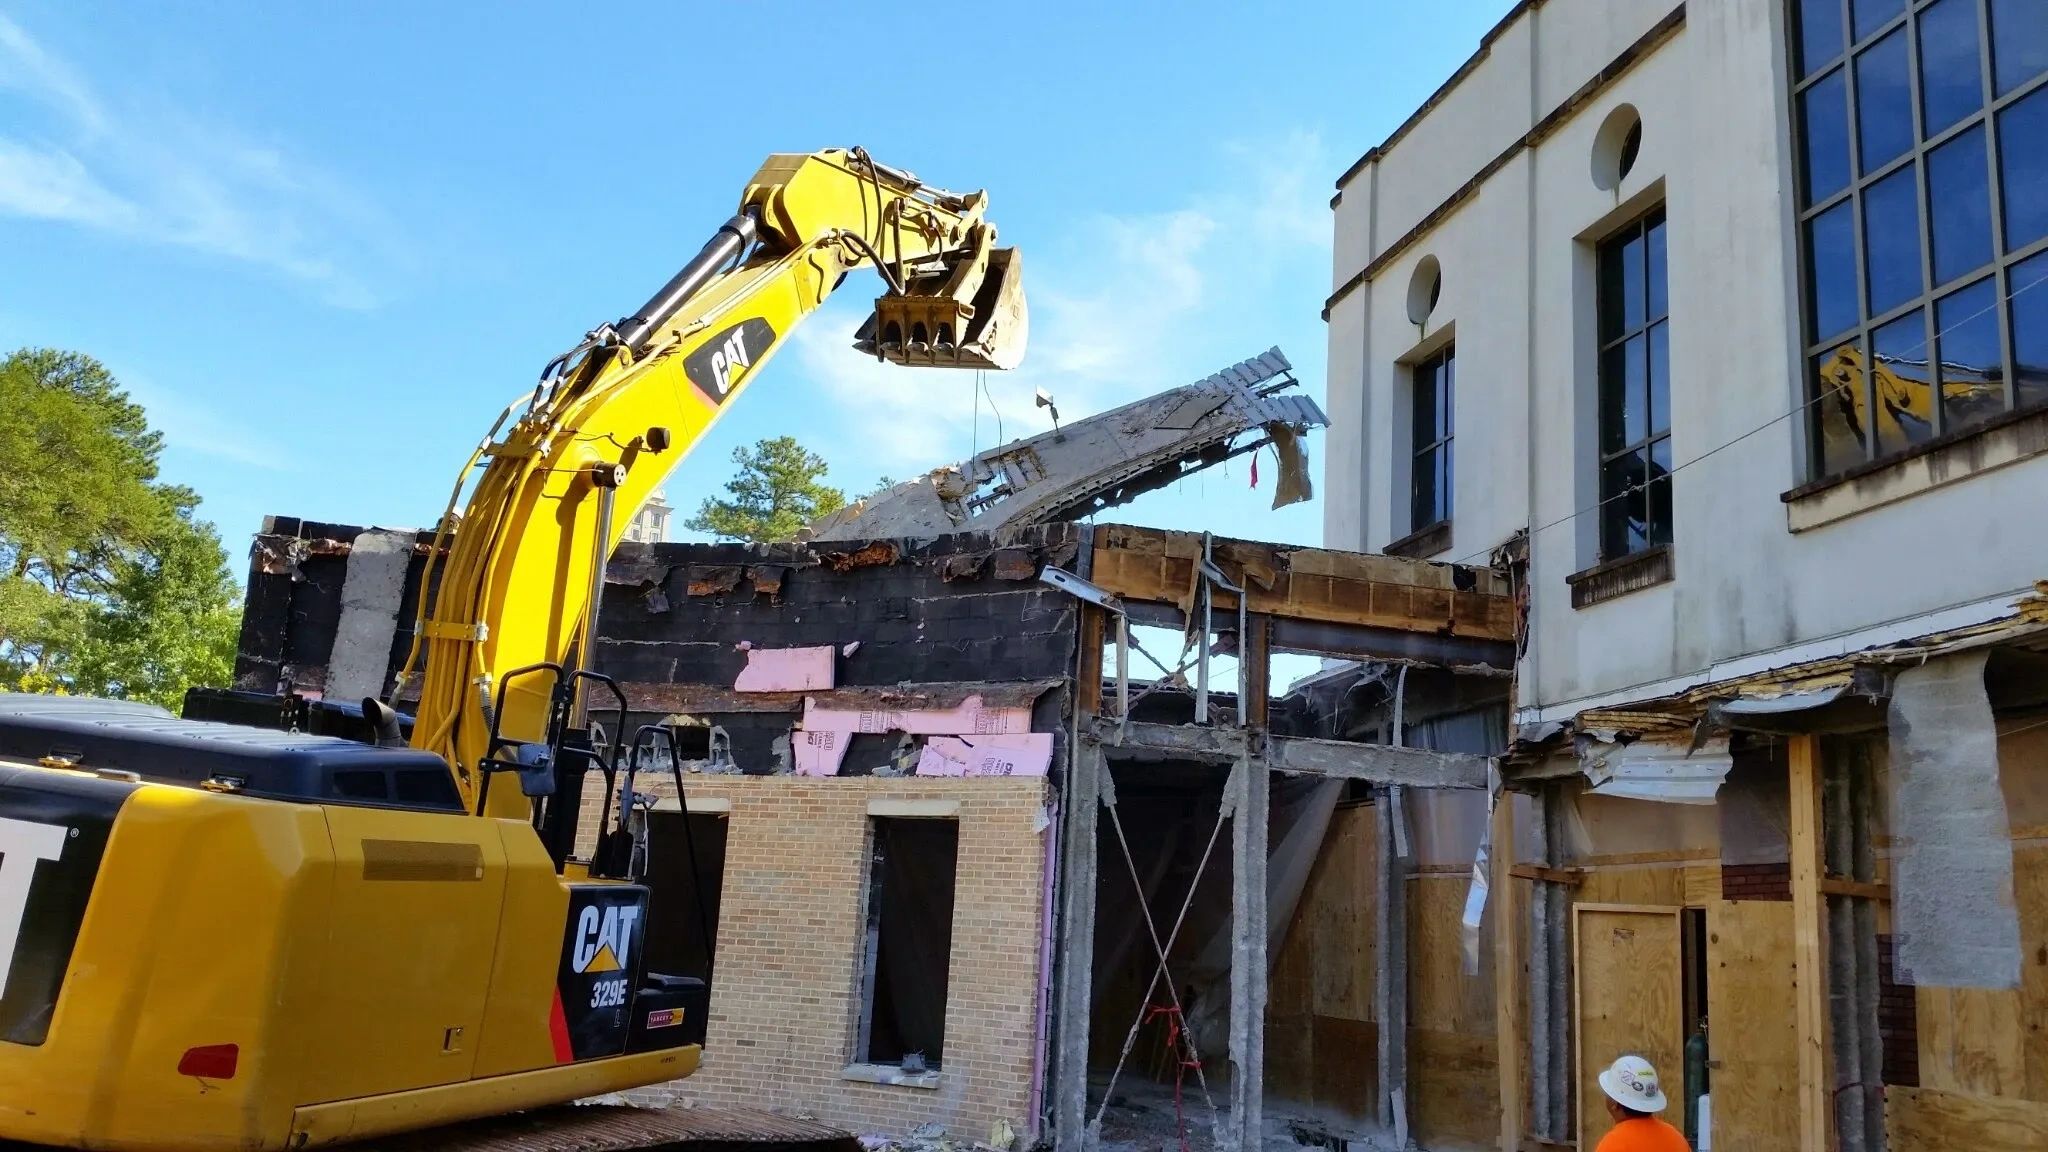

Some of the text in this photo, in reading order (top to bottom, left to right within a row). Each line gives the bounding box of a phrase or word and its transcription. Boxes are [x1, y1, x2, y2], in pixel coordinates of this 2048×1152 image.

[711, 325, 750, 395] CAT
[572, 905, 639, 974] CAT
[590, 979, 628, 1009] 329E
